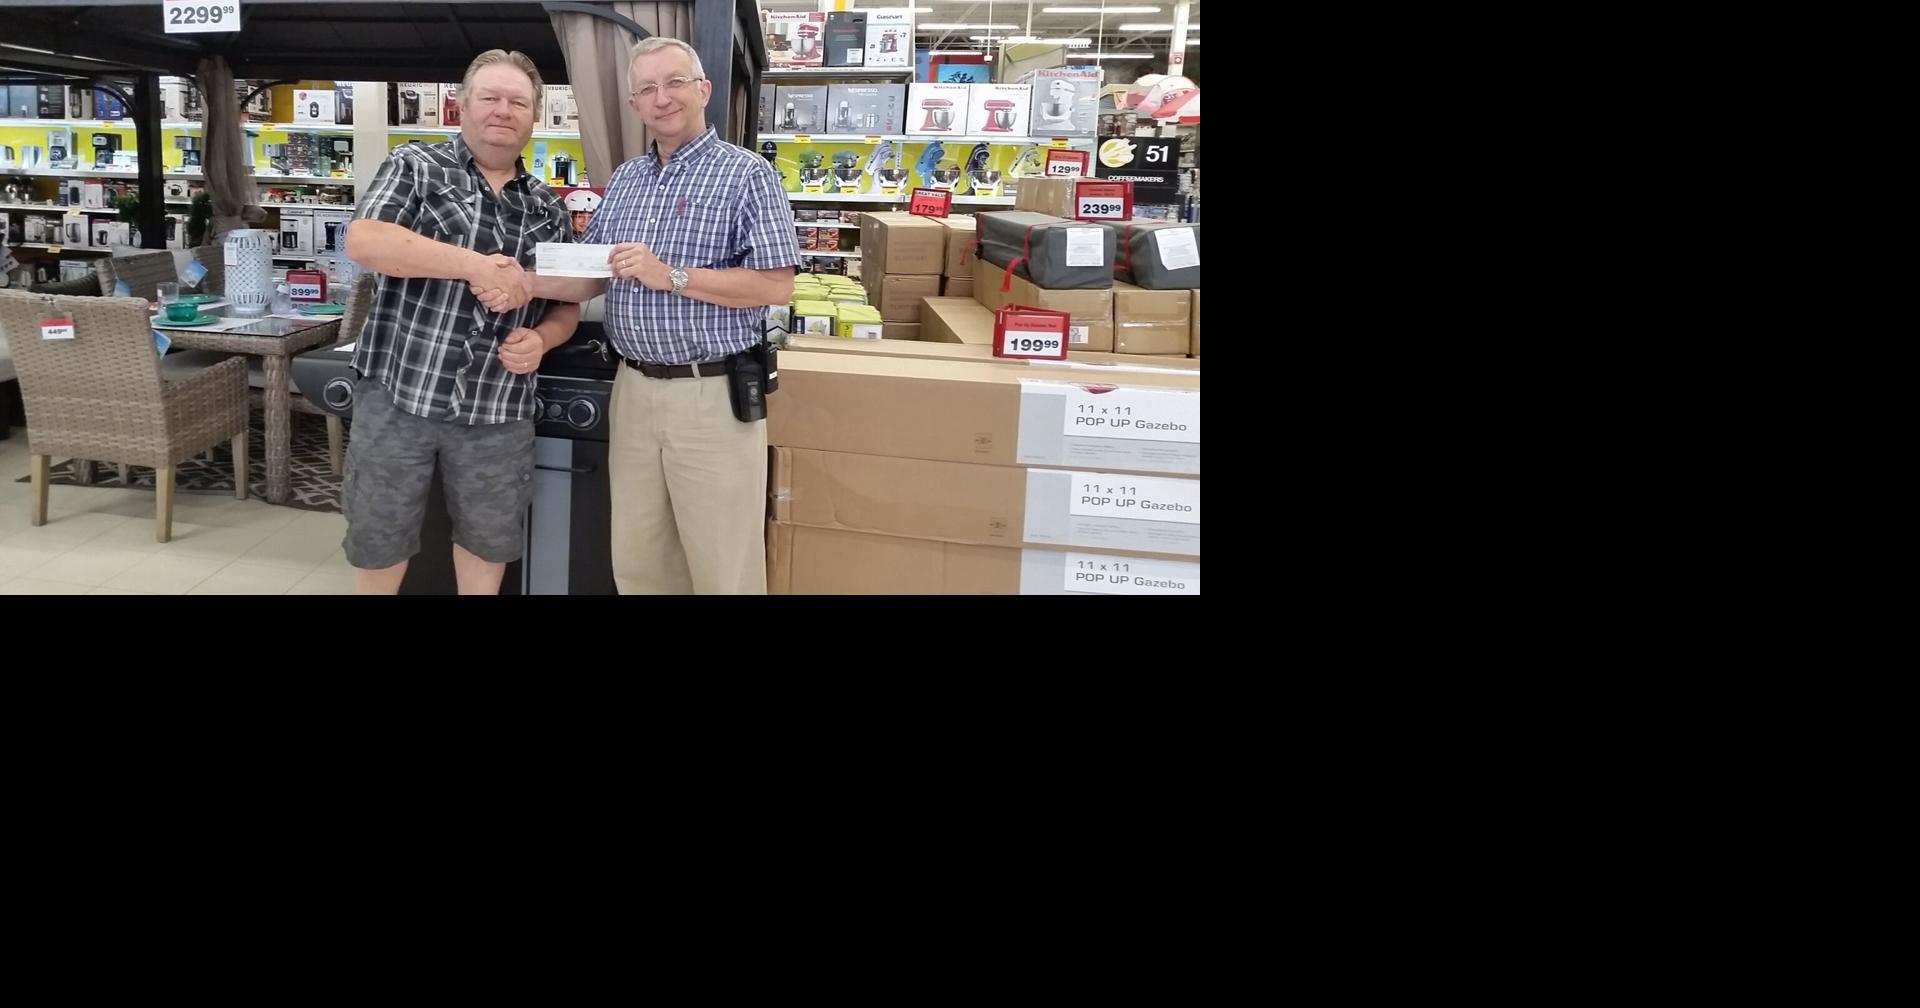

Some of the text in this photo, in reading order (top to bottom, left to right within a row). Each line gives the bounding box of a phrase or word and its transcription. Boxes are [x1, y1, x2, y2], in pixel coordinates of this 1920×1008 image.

[1038, 70, 1100, 78] KitchenAid
[1145, 145, 1169, 162] 51
[1078, 405, 1094, 413] 11
[1115, 407, 1131, 415] 11
[1076, 417, 1187, 431] POP UP Gazebo
[1083, 484, 1100, 493] 11
[1120, 486, 1136, 495] 11
[1082, 496, 1192, 512] POP UP Gazebo
[1077, 560, 1094, 570] 11
[1113, 562, 1129, 572] 11
[1076, 572, 1186, 590] POP UP Gazebo
